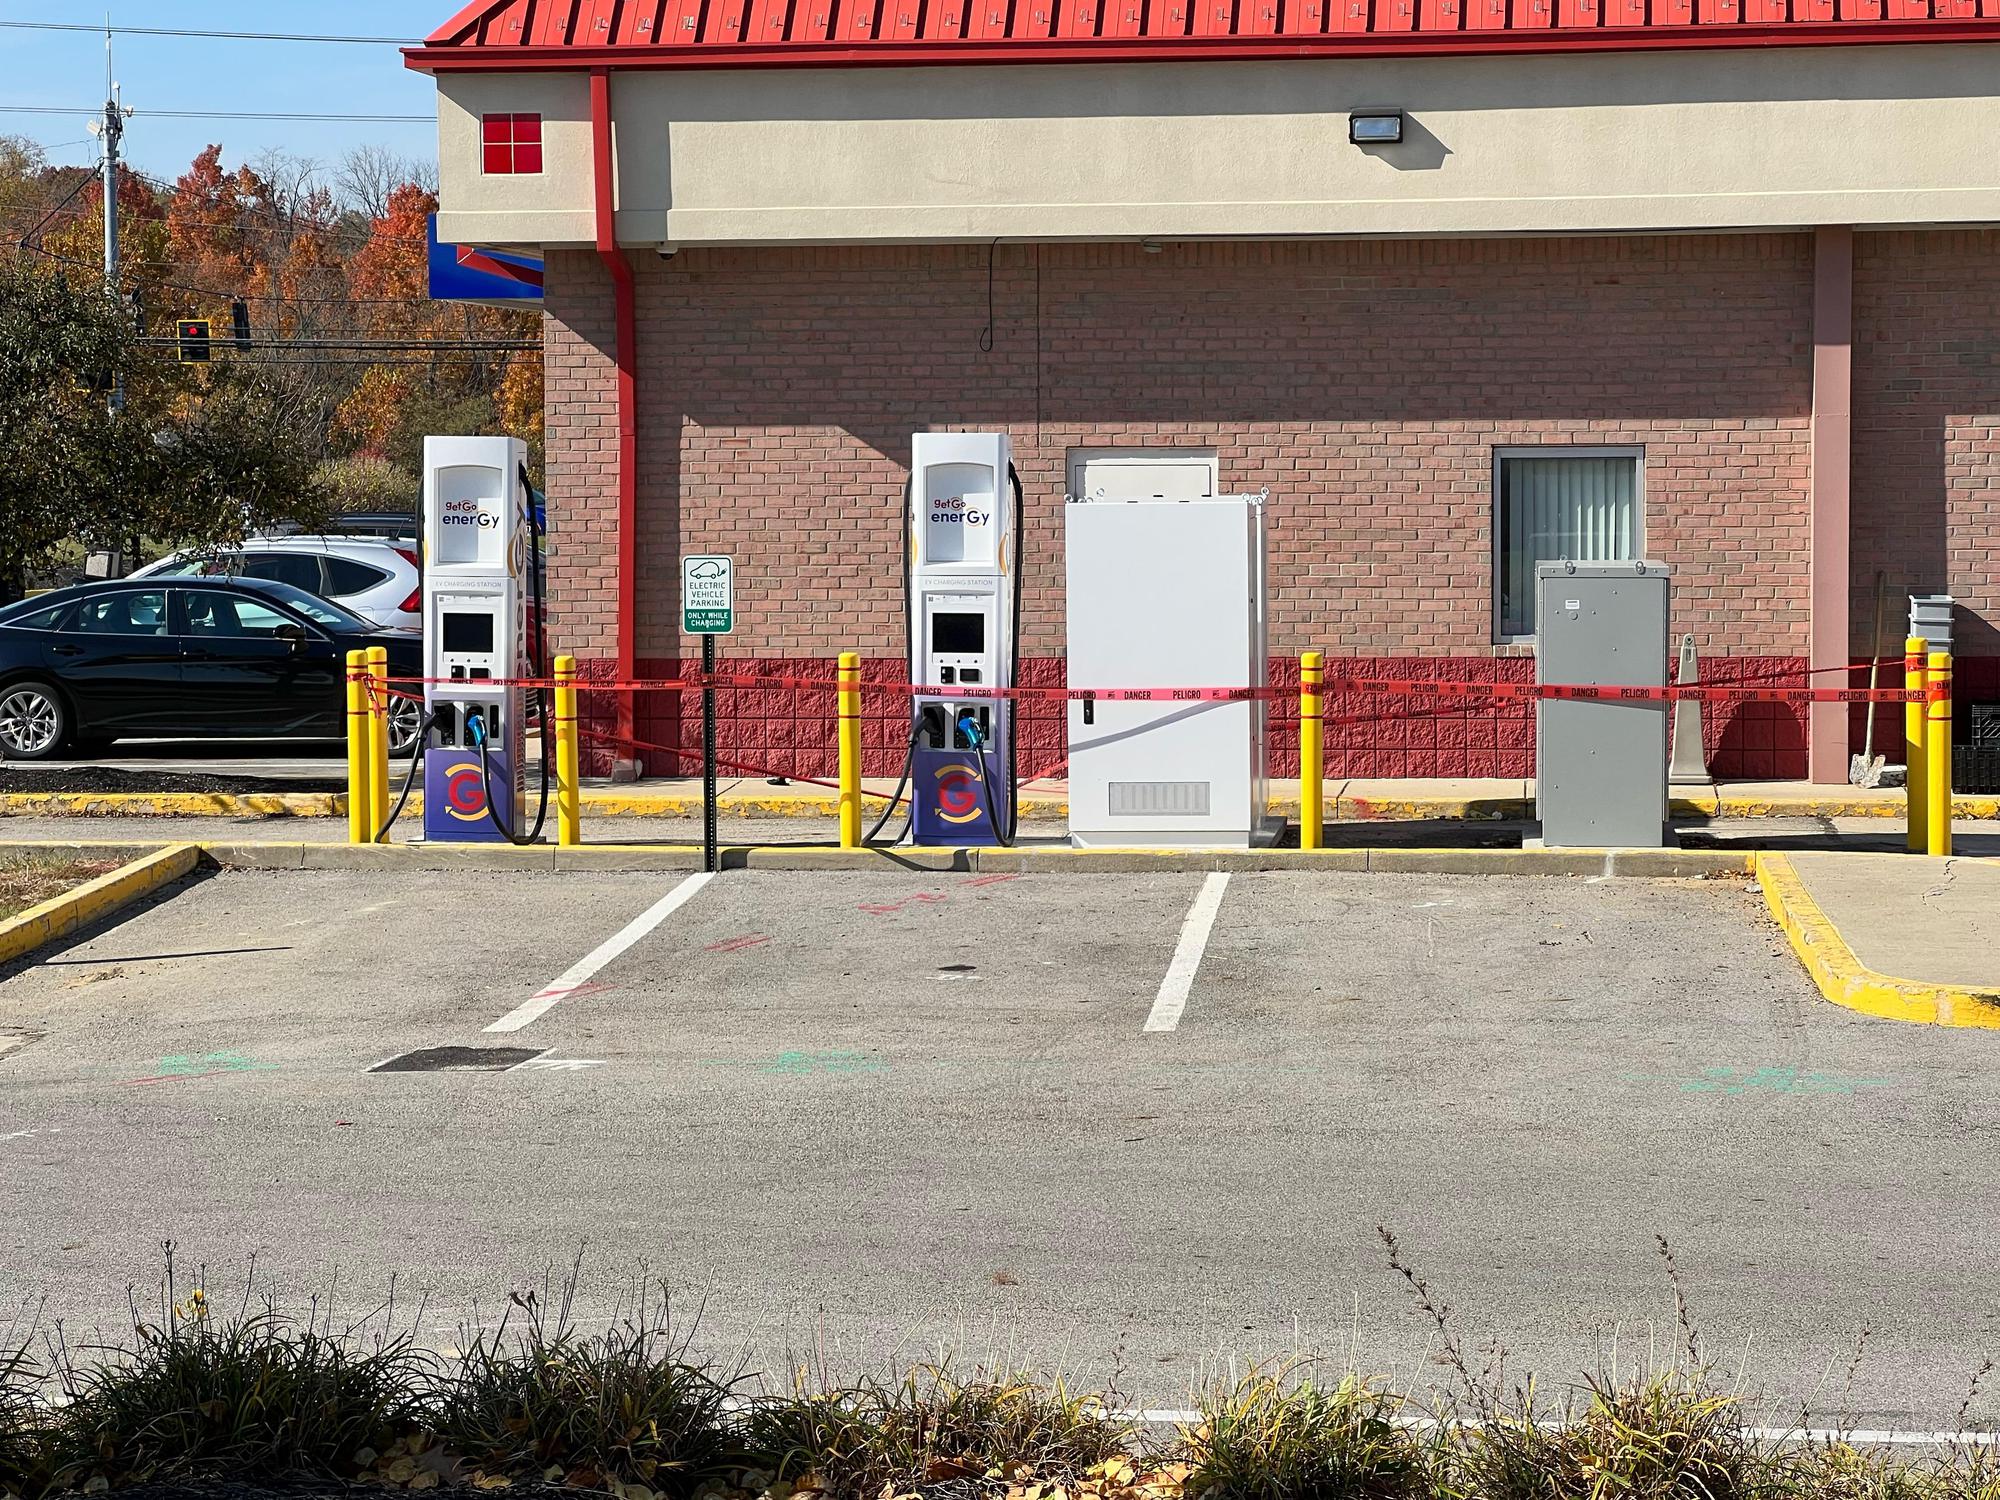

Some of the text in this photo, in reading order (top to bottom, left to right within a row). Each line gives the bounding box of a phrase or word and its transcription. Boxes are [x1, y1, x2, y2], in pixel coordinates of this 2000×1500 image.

[442, 513, 500, 528] enerGy
[931, 510, 989, 526] enerGy
[755, 678, 783, 689] PELIGRO
[810, 682, 837, 691] DANGER
[859, 684, 887, 693] PELIGRO
[915, 687, 942, 695] DANGER
[963, 689, 992, 697] PELIGRO
[1019, 691, 1047, 699] DANGER
[1068, 691, 1097, 700] PELIGRO
[1124, 691, 1151, 700] DANGER
[1172, 690, 1201, 699] PELIGRO
[1228, 689, 1255, 699] DANGER
[1362, 682, 1389, 691] DANGER
[1410, 683, 1438, 693] PELIGRO
[1466, 685, 1493, 695] DANGER
[1515, 686, 1543, 696] PELIGRO
[1571, 687, 1599, 697] DANGER
[1621, 688, 1650, 698] PELIGRO
[1678, 690, 1706, 699] DANGER
[1728, 690, 1758, 700] PELIGRO
[1787, 691, 1815, 700] DANGER
[1838, 691, 1868, 700] PELIGRO
[1897, 690, 1927, 700] DANGER
[448, 772, 485, 812] G
[938, 775, 976, 814] G
